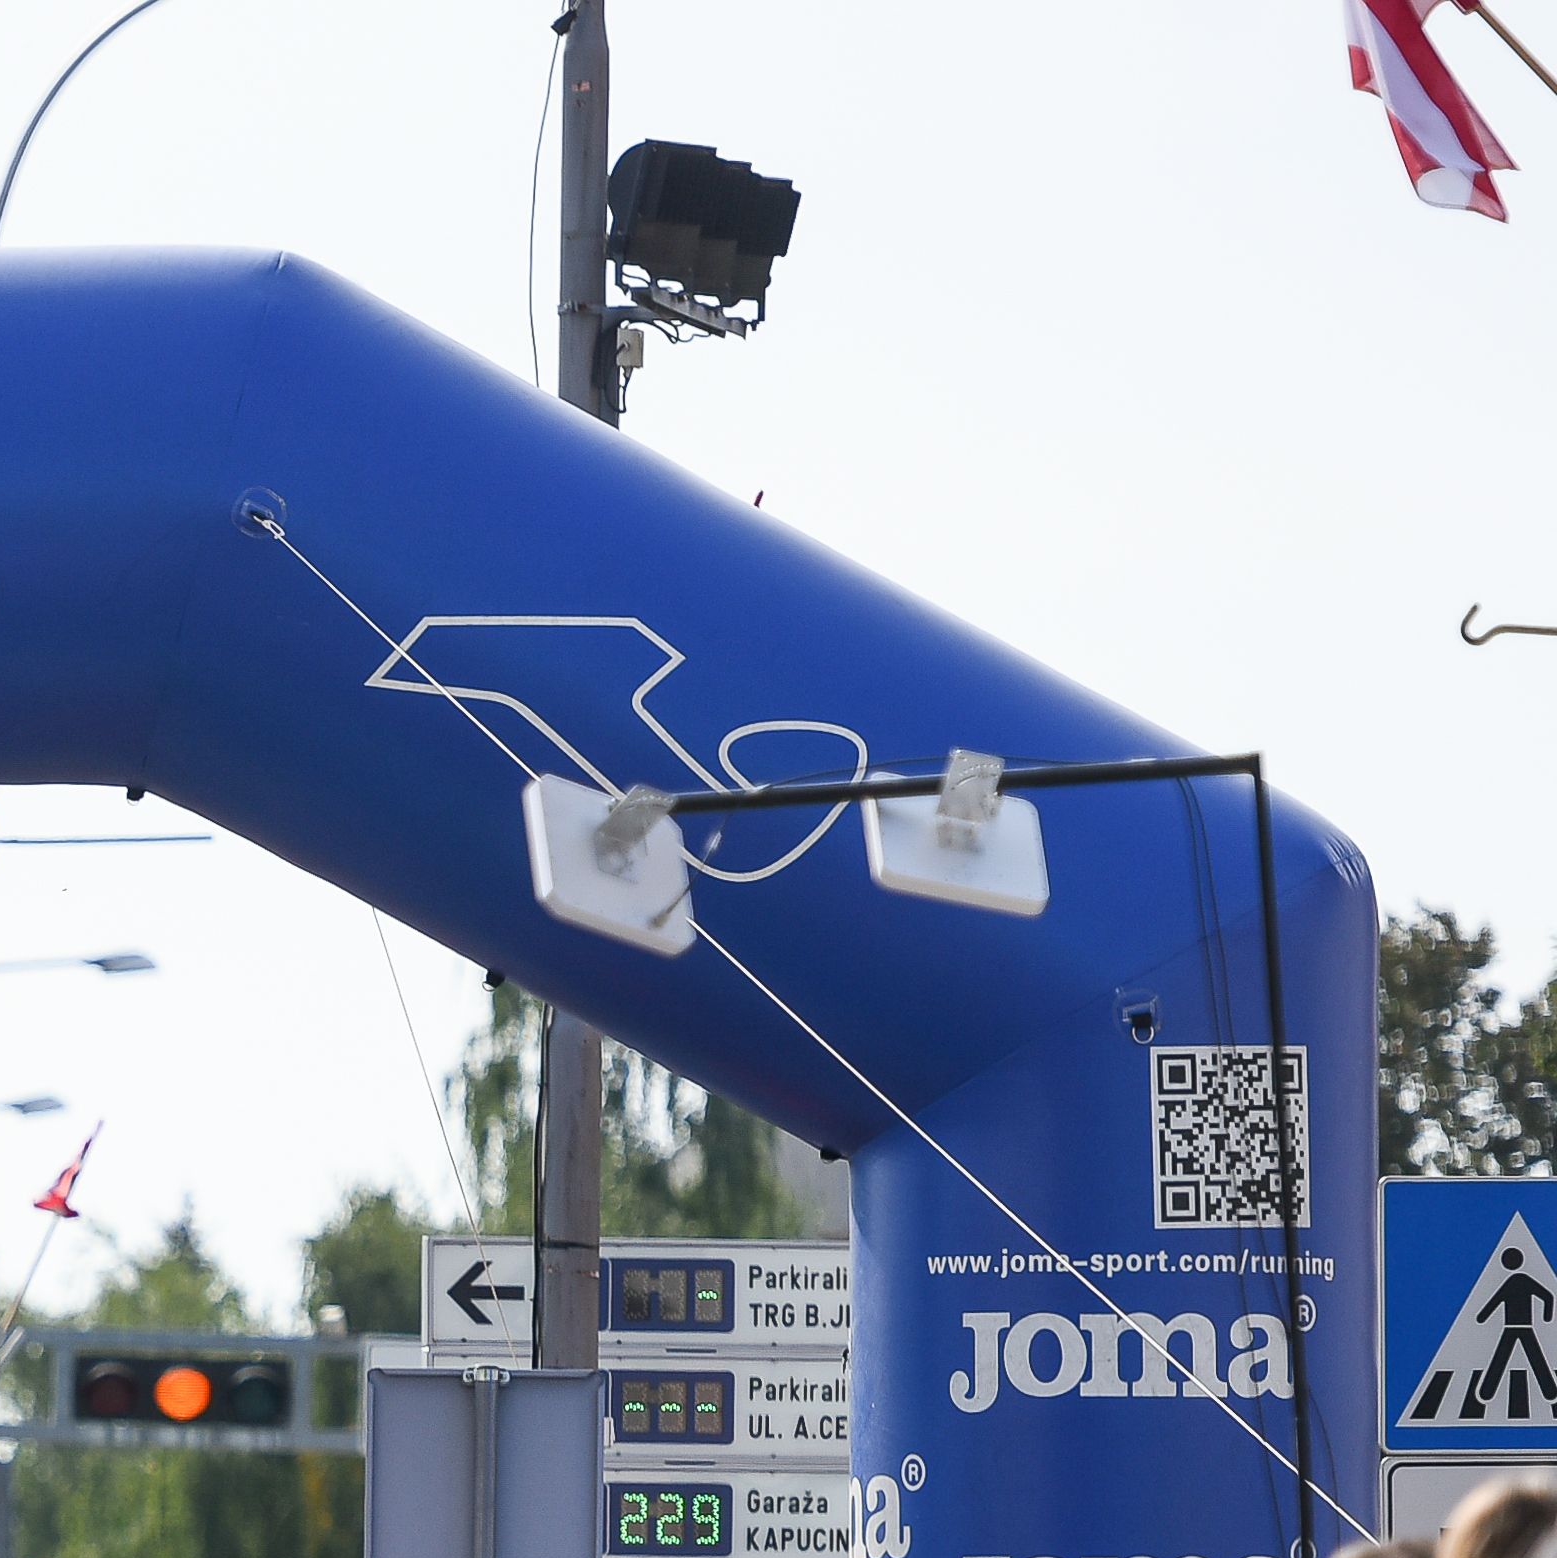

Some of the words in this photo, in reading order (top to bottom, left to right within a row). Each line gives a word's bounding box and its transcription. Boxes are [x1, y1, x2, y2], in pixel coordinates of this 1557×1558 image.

[749, 1303, 795, 1327] TRG
[749, 1414, 783, 1439] UL.
[747, 1489, 828, 1514] Garaža
[620, 1492, 721, 1545] 229
